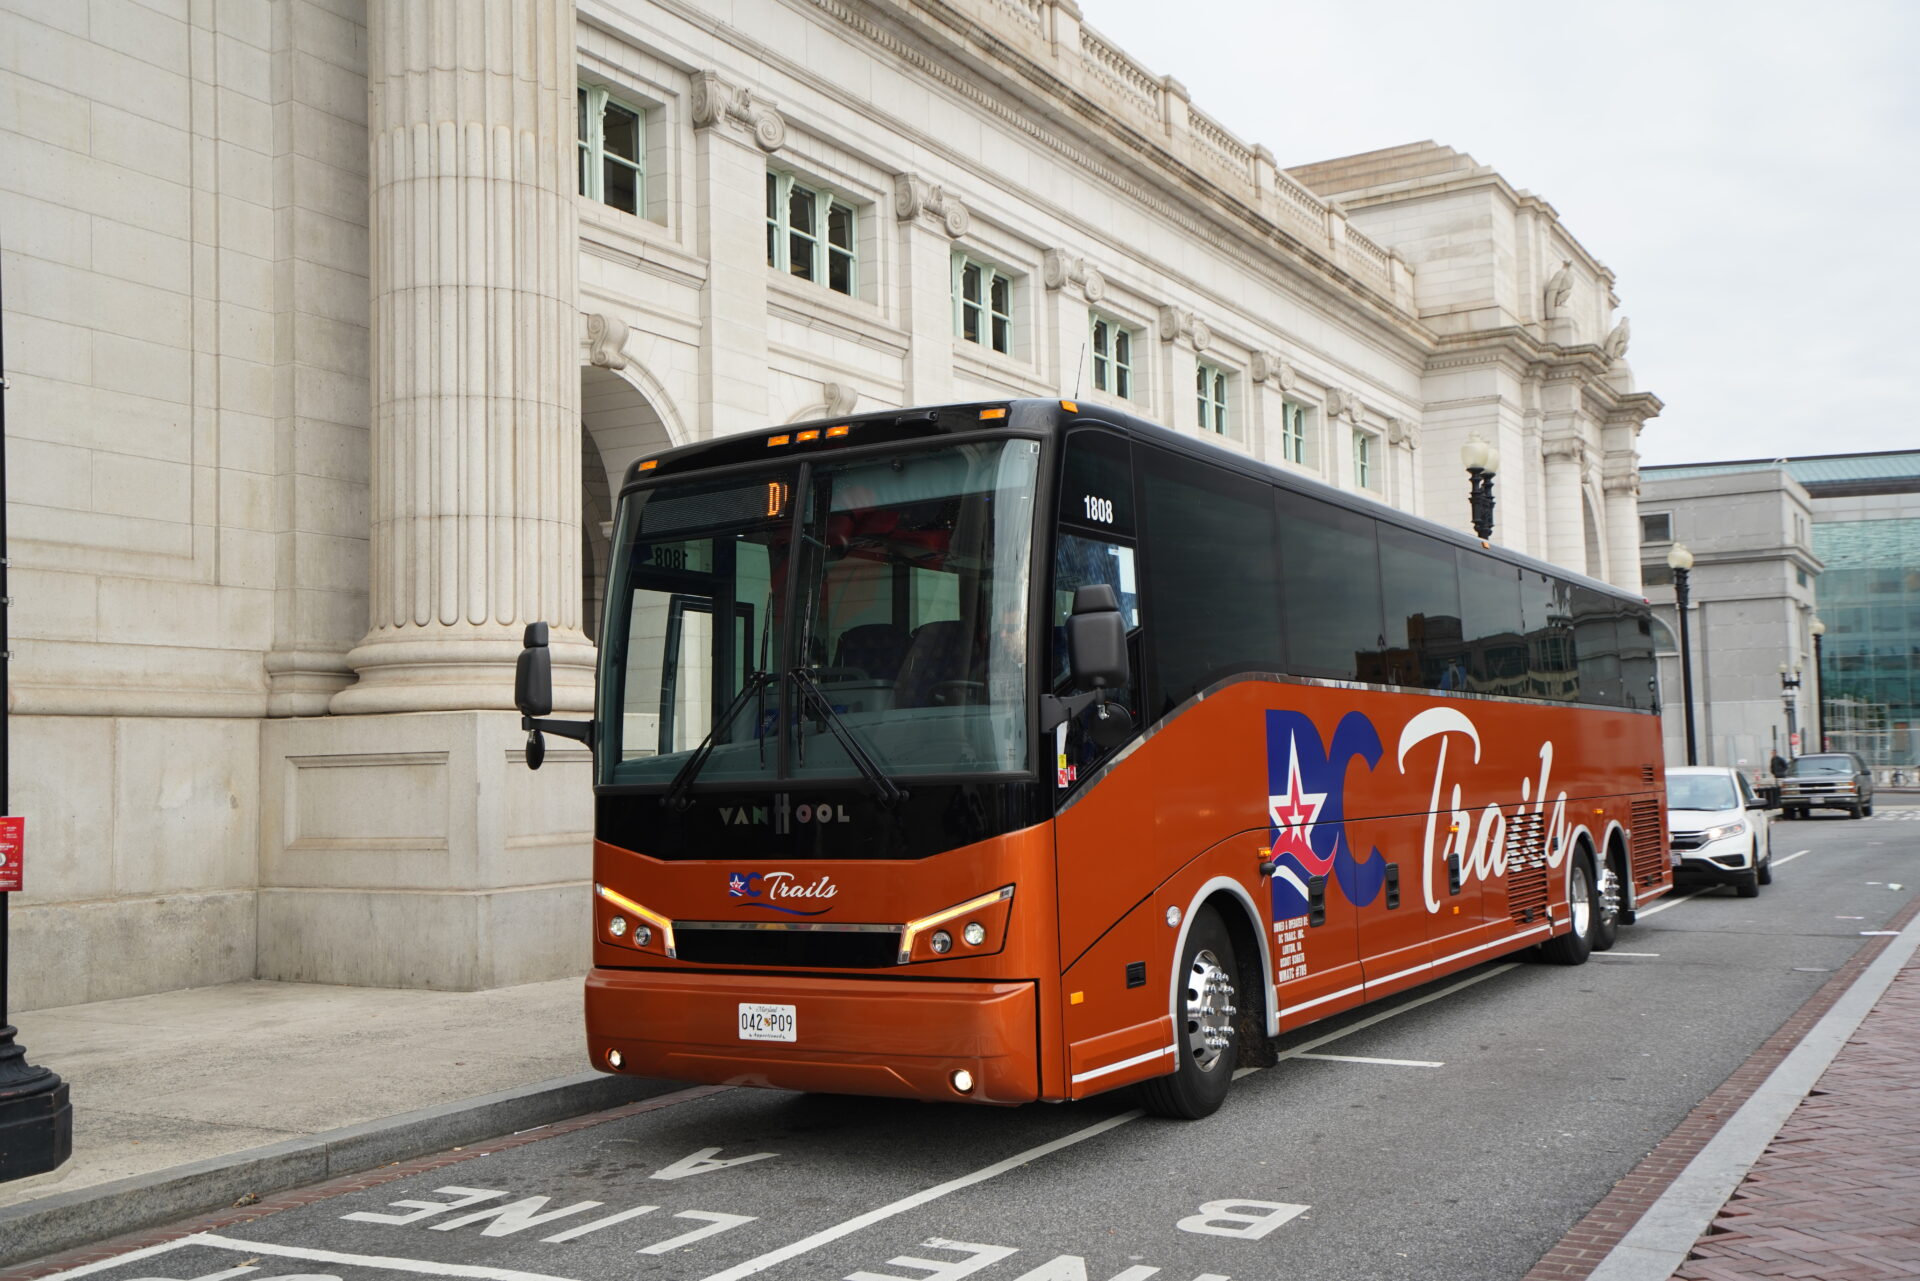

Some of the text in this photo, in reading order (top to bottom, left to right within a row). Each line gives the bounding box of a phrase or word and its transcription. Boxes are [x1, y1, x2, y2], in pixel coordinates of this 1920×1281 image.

[1083, 495, 1113, 524] 1808
[719, 793, 850, 835] VAN HOOL
[1265, 706, 1572, 922] DC Trails
[728, 871, 839, 900] DC Trails
[741, 1013, 763, 1031] 042
[756, 1006, 778, 1015] Maryland
[649, 1146, 781, 1181] A
[339, 1185, 759, 1255] LINE
[1176, 1198, 1312, 1241] B
